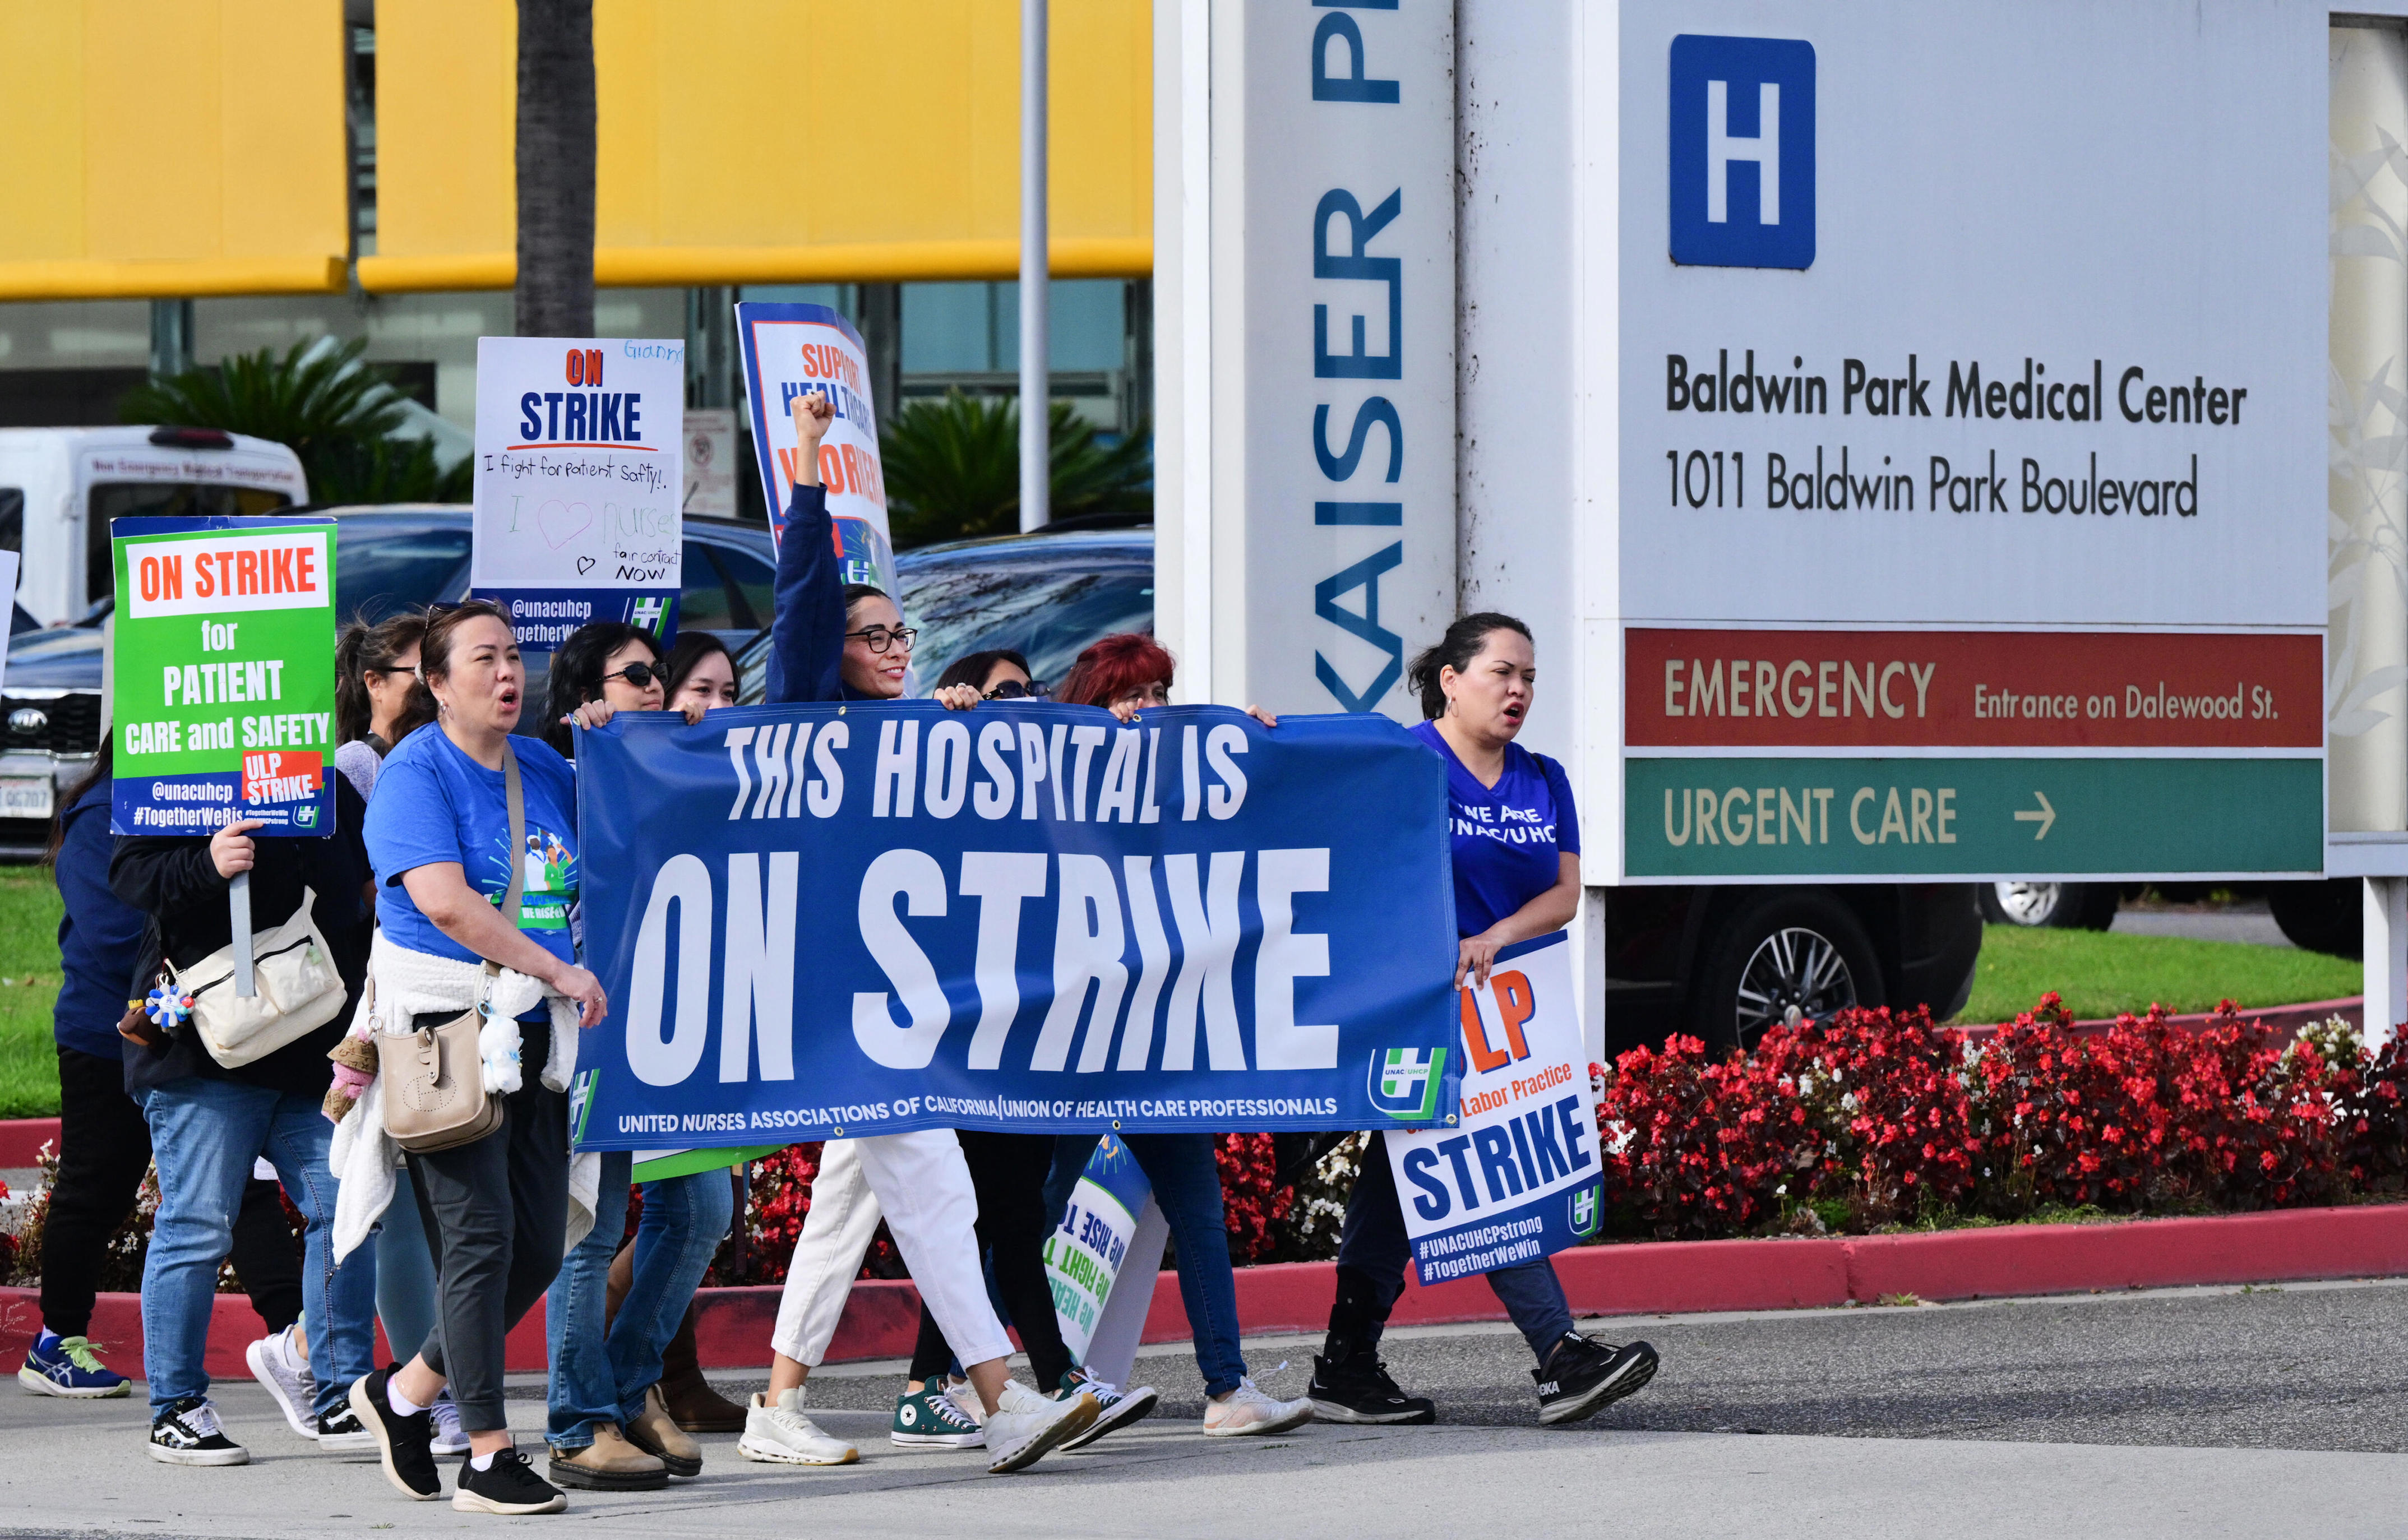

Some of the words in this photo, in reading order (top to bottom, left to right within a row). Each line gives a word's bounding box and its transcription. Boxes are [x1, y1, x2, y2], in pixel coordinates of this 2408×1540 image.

[1312, 0, 1401, 104] P
[566, 349, 603, 387] ON
[802, 343, 862, 397] SUPPORT
[1666, 348, 1827, 414] Baldwin
[1843, 353, 1932, 417] Park
[1945, 357, 2102, 422] Medical
[2118, 366, 2248, 426] Center
[520, 392, 641, 441] STRIKE
[484, 455, 494, 472] I
[501, 454, 536, 479] fight
[539, 455, 562, 475] for
[565, 455, 614, 479] patient
[1666, 450, 1743, 508] 1011
[1767, 445, 1914, 511] Baldwin
[1930, 449, 2008, 513] Park
[2022, 451, 2198, 517] Boulevard
[509, 495, 524, 533] I
[140, 554, 183, 602] ON
[195, 547, 316, 598] STRIKE
[615, 565, 665, 582] NOW
[511, 599, 591, 619] @unacuhcp
[201, 620, 238, 651] for
[163, 660, 284, 706] PATIENT
[1665, 658, 1936, 719] EMERGENCY
[1975, 683, 2078, 719] Entrance
[2086, 695, 2116, 719] on
[2125, 680, 2243, 719] Dalewood
[2250, 685, 2278, 720] St.
[125, 720, 182, 755] CARE
[188, 717, 234, 751] and
[242, 712, 330, 748] SAFETY
[245, 752, 281, 781] ULP
[723, 720, 849, 821] THIS
[872, 720, 1161, 824] HOSPITAL
[1181, 723, 1249, 822] IS
[152, 781, 233, 802] @unacuhcp
[247, 774, 315, 806] STRIKE
[1449, 817, 1557, 844] NAC/UHC
[1500, 804, 1543, 824] ARE
[1664, 787, 1834, 846] URGENT
[1850, 787, 1957, 845] CARE
[625, 850, 800, 1087] ON
[851, 847, 1339, 1074] STRIKE
[1460, 969, 1536, 1080] LP
[1460, 1085, 1508, 1118] Labor
[1511, 1062, 1572, 1101] Practice
[618, 1114, 679, 1133] UNITED
[682, 1112, 747, 1132] NURSES
[750, 1102, 890, 1129] ASSOCIATIONS
[893, 1096, 921, 1116] OF
[1052, 1100, 1074, 1118] OF
[1075, 1100, 1138, 1118] HEALTH
[1140, 1099, 1187, 1118] CARE
[1189, 1097, 1338, 1117] PROFESSIONALS
[1402, 1094, 1592, 1222] STRIKE
[1042, 1237, 1057, 1267] T
[1079, 1211, 1112, 1259] RISE
[1418, 1215, 1543, 1260] #UNACUHCPstrong
[1058, 1245, 1099, 1293] FIGHT
[1423, 1239, 1541, 1282] #TogetherWeWin
[1565, 1331, 1586, 1343] HOK
